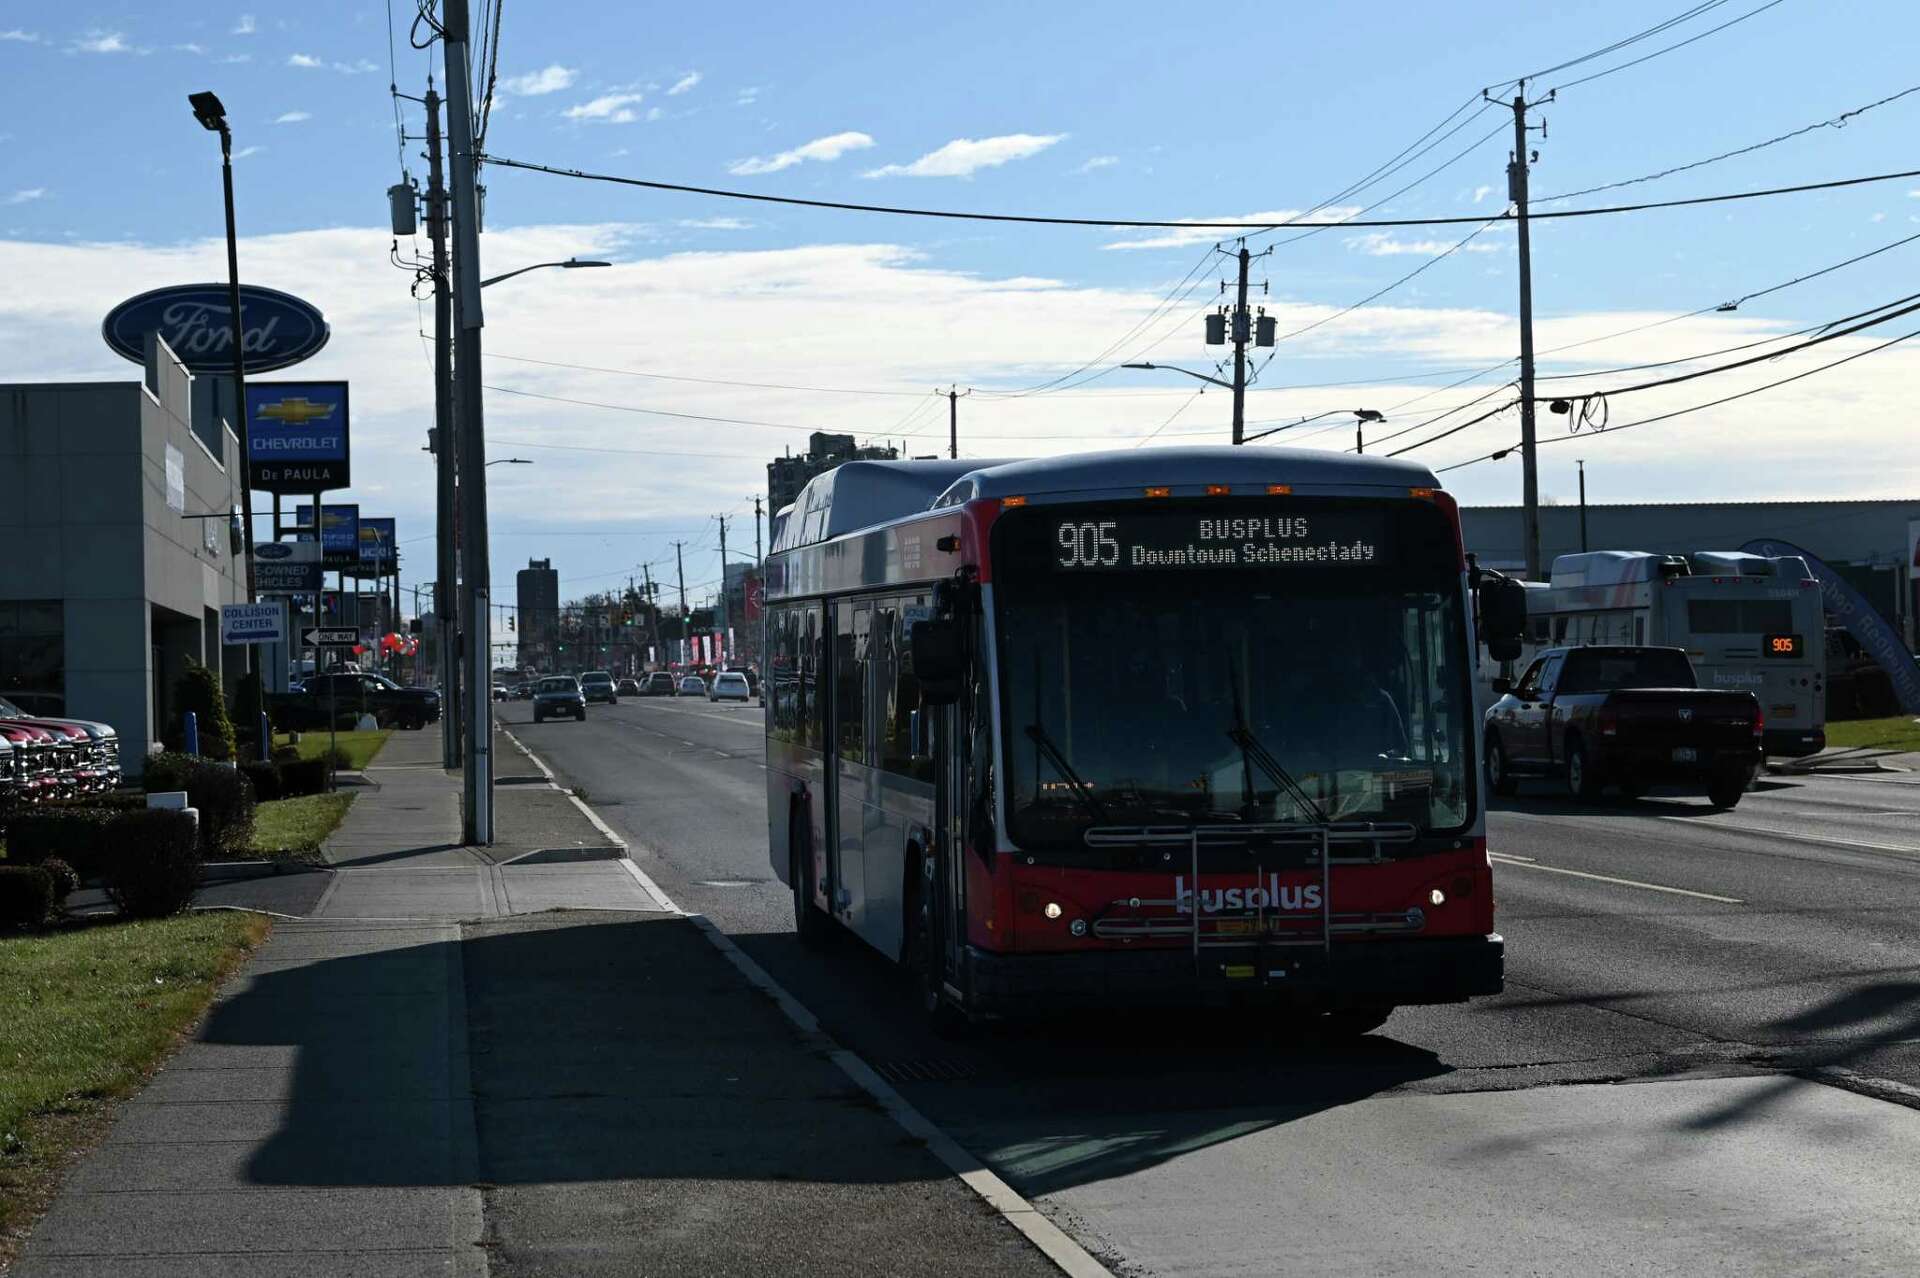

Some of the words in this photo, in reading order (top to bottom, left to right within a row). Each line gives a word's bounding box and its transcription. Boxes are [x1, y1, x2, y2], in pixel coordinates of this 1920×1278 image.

[163, 301, 280, 353] Ford
[252, 436, 339, 450] CHEVROLET
[284, 468, 331, 480] PAULA
[1200, 517, 1308, 540] BUSPLUS
[1057, 521, 1120, 568] 905
[1131, 544, 1237, 566] Downtown
[1242, 540, 1375, 564] Schenectady
[255, 576, 304, 586] EHICLES
[224, 607, 279, 618] COLLISION
[232, 619, 273, 629] CENTER
[318, 633, 333, 641] ONE
[338, 633, 354, 641] WAY
[1771, 637, 1794, 652] 905
[1713, 669, 1763, 687] busplus
[1175, 872, 1323, 915] busplus
